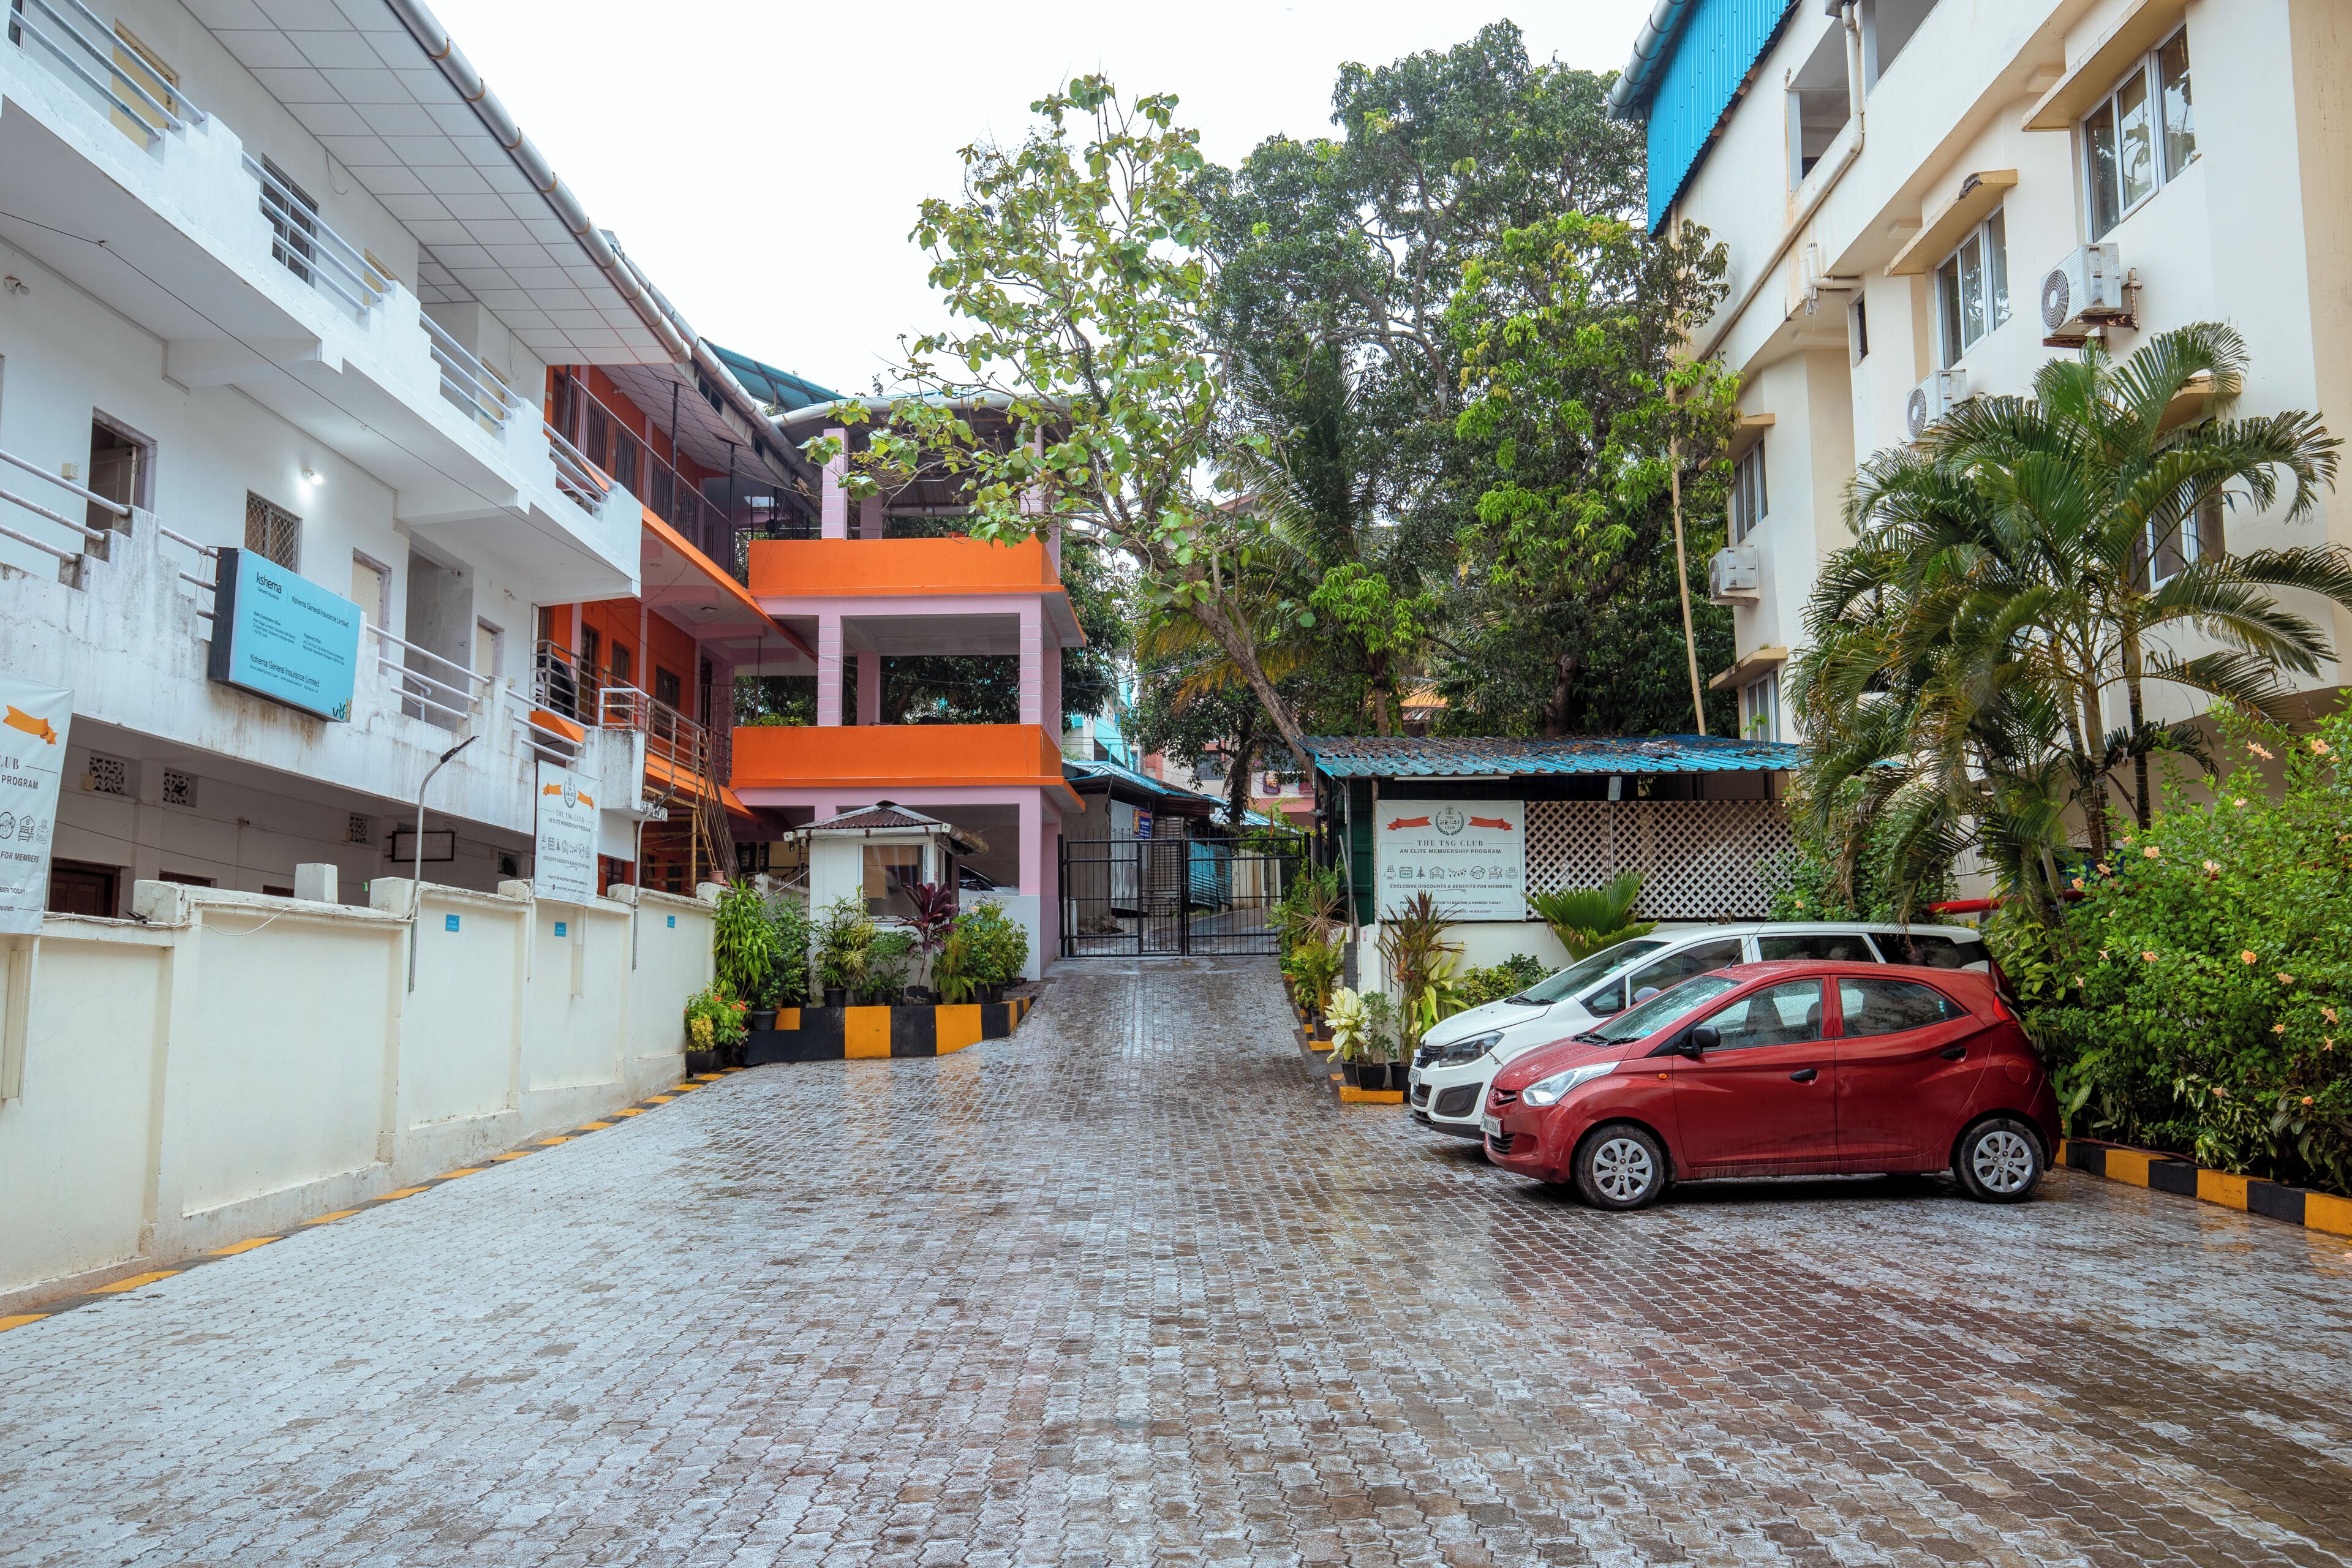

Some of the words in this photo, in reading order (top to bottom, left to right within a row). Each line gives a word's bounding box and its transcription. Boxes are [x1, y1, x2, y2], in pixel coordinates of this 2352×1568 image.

[256, 571, 282, 594] kshema
[257, 586, 268, 595] General
[292, 595, 307, 608] Kshema
[306, 602, 320, 614] General
[320, 609, 336, 623] Insurance
[336, 616, 349, 628] Limited
[250, 653, 268, 668] Kshema
[268, 660, 285, 674] General
[285, 666, 304, 682] Insurance
[305, 675, 320, 687] Limited
[1, 774, 38, 790] PROGRAM
[0, 851, 13, 859] FOR
[14, 853, 40, 863] MEMBERS
